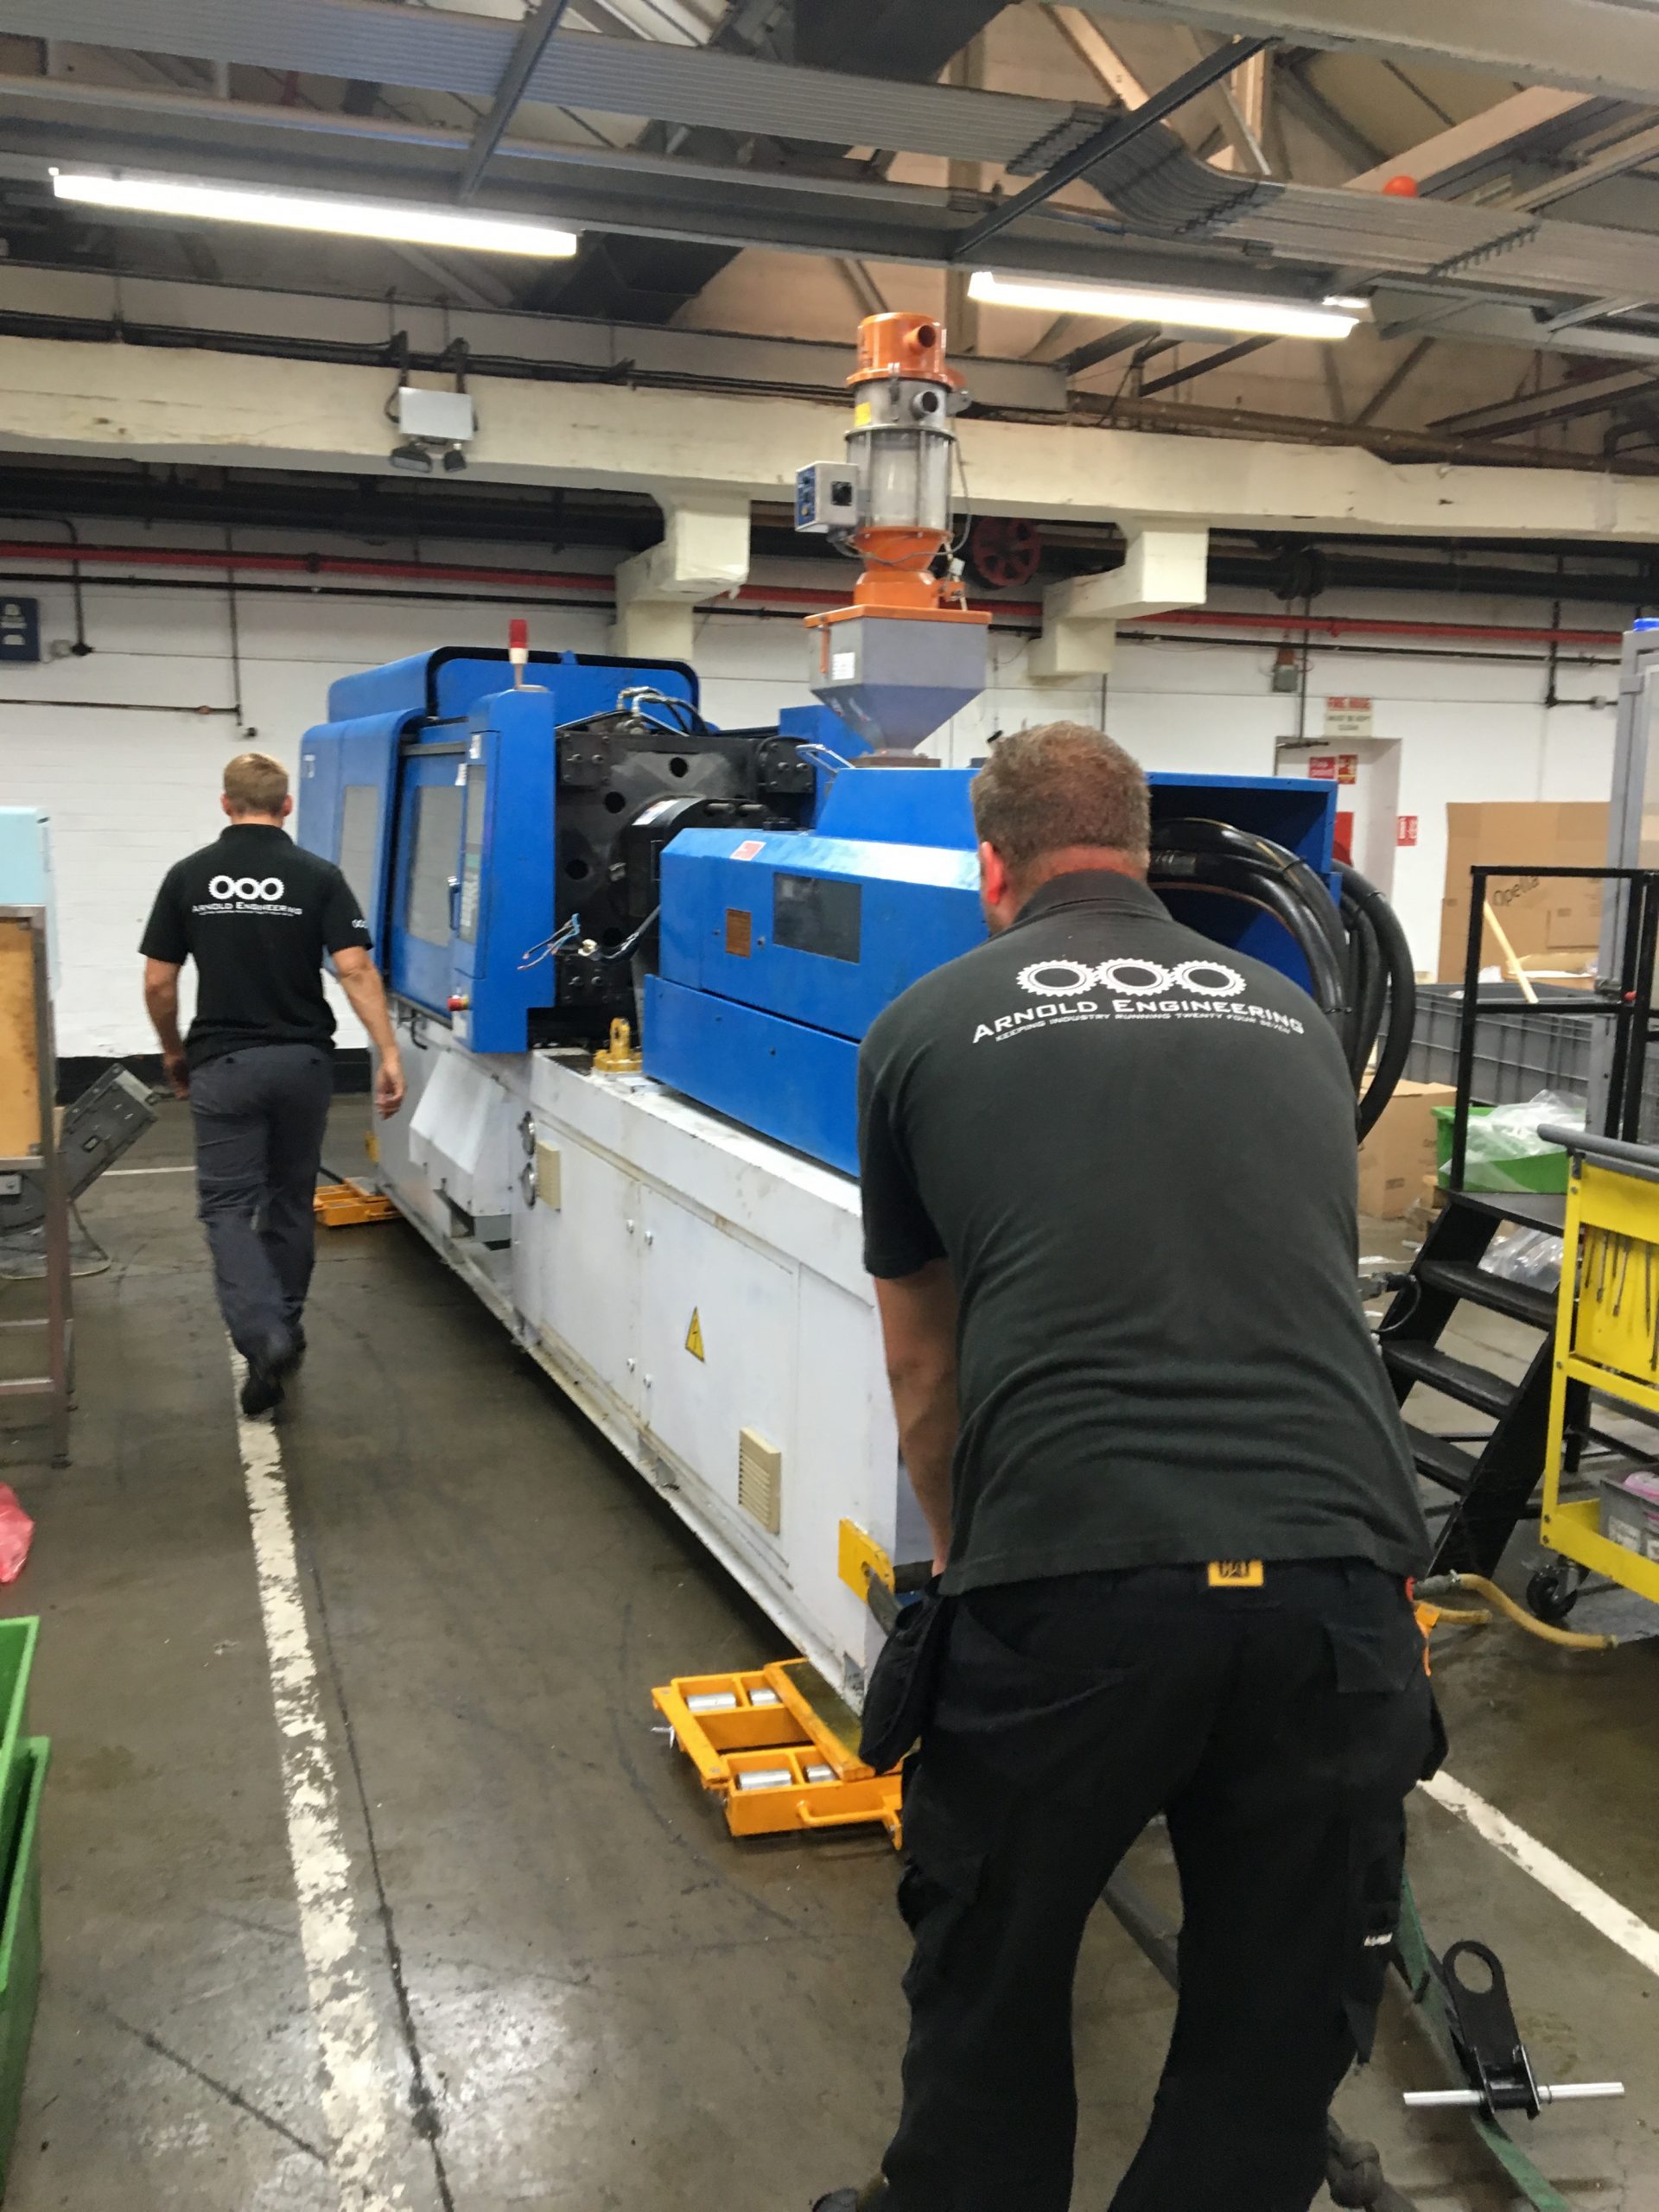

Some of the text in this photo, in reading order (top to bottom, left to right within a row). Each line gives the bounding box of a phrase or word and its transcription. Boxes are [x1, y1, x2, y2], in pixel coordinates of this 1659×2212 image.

[192, 903, 233, 912] ARNOLD
[972, 999, 1305, 1044] ARNOLD ENGINEERING
[1049, 1014, 1110, 1025] INDUSTRY
